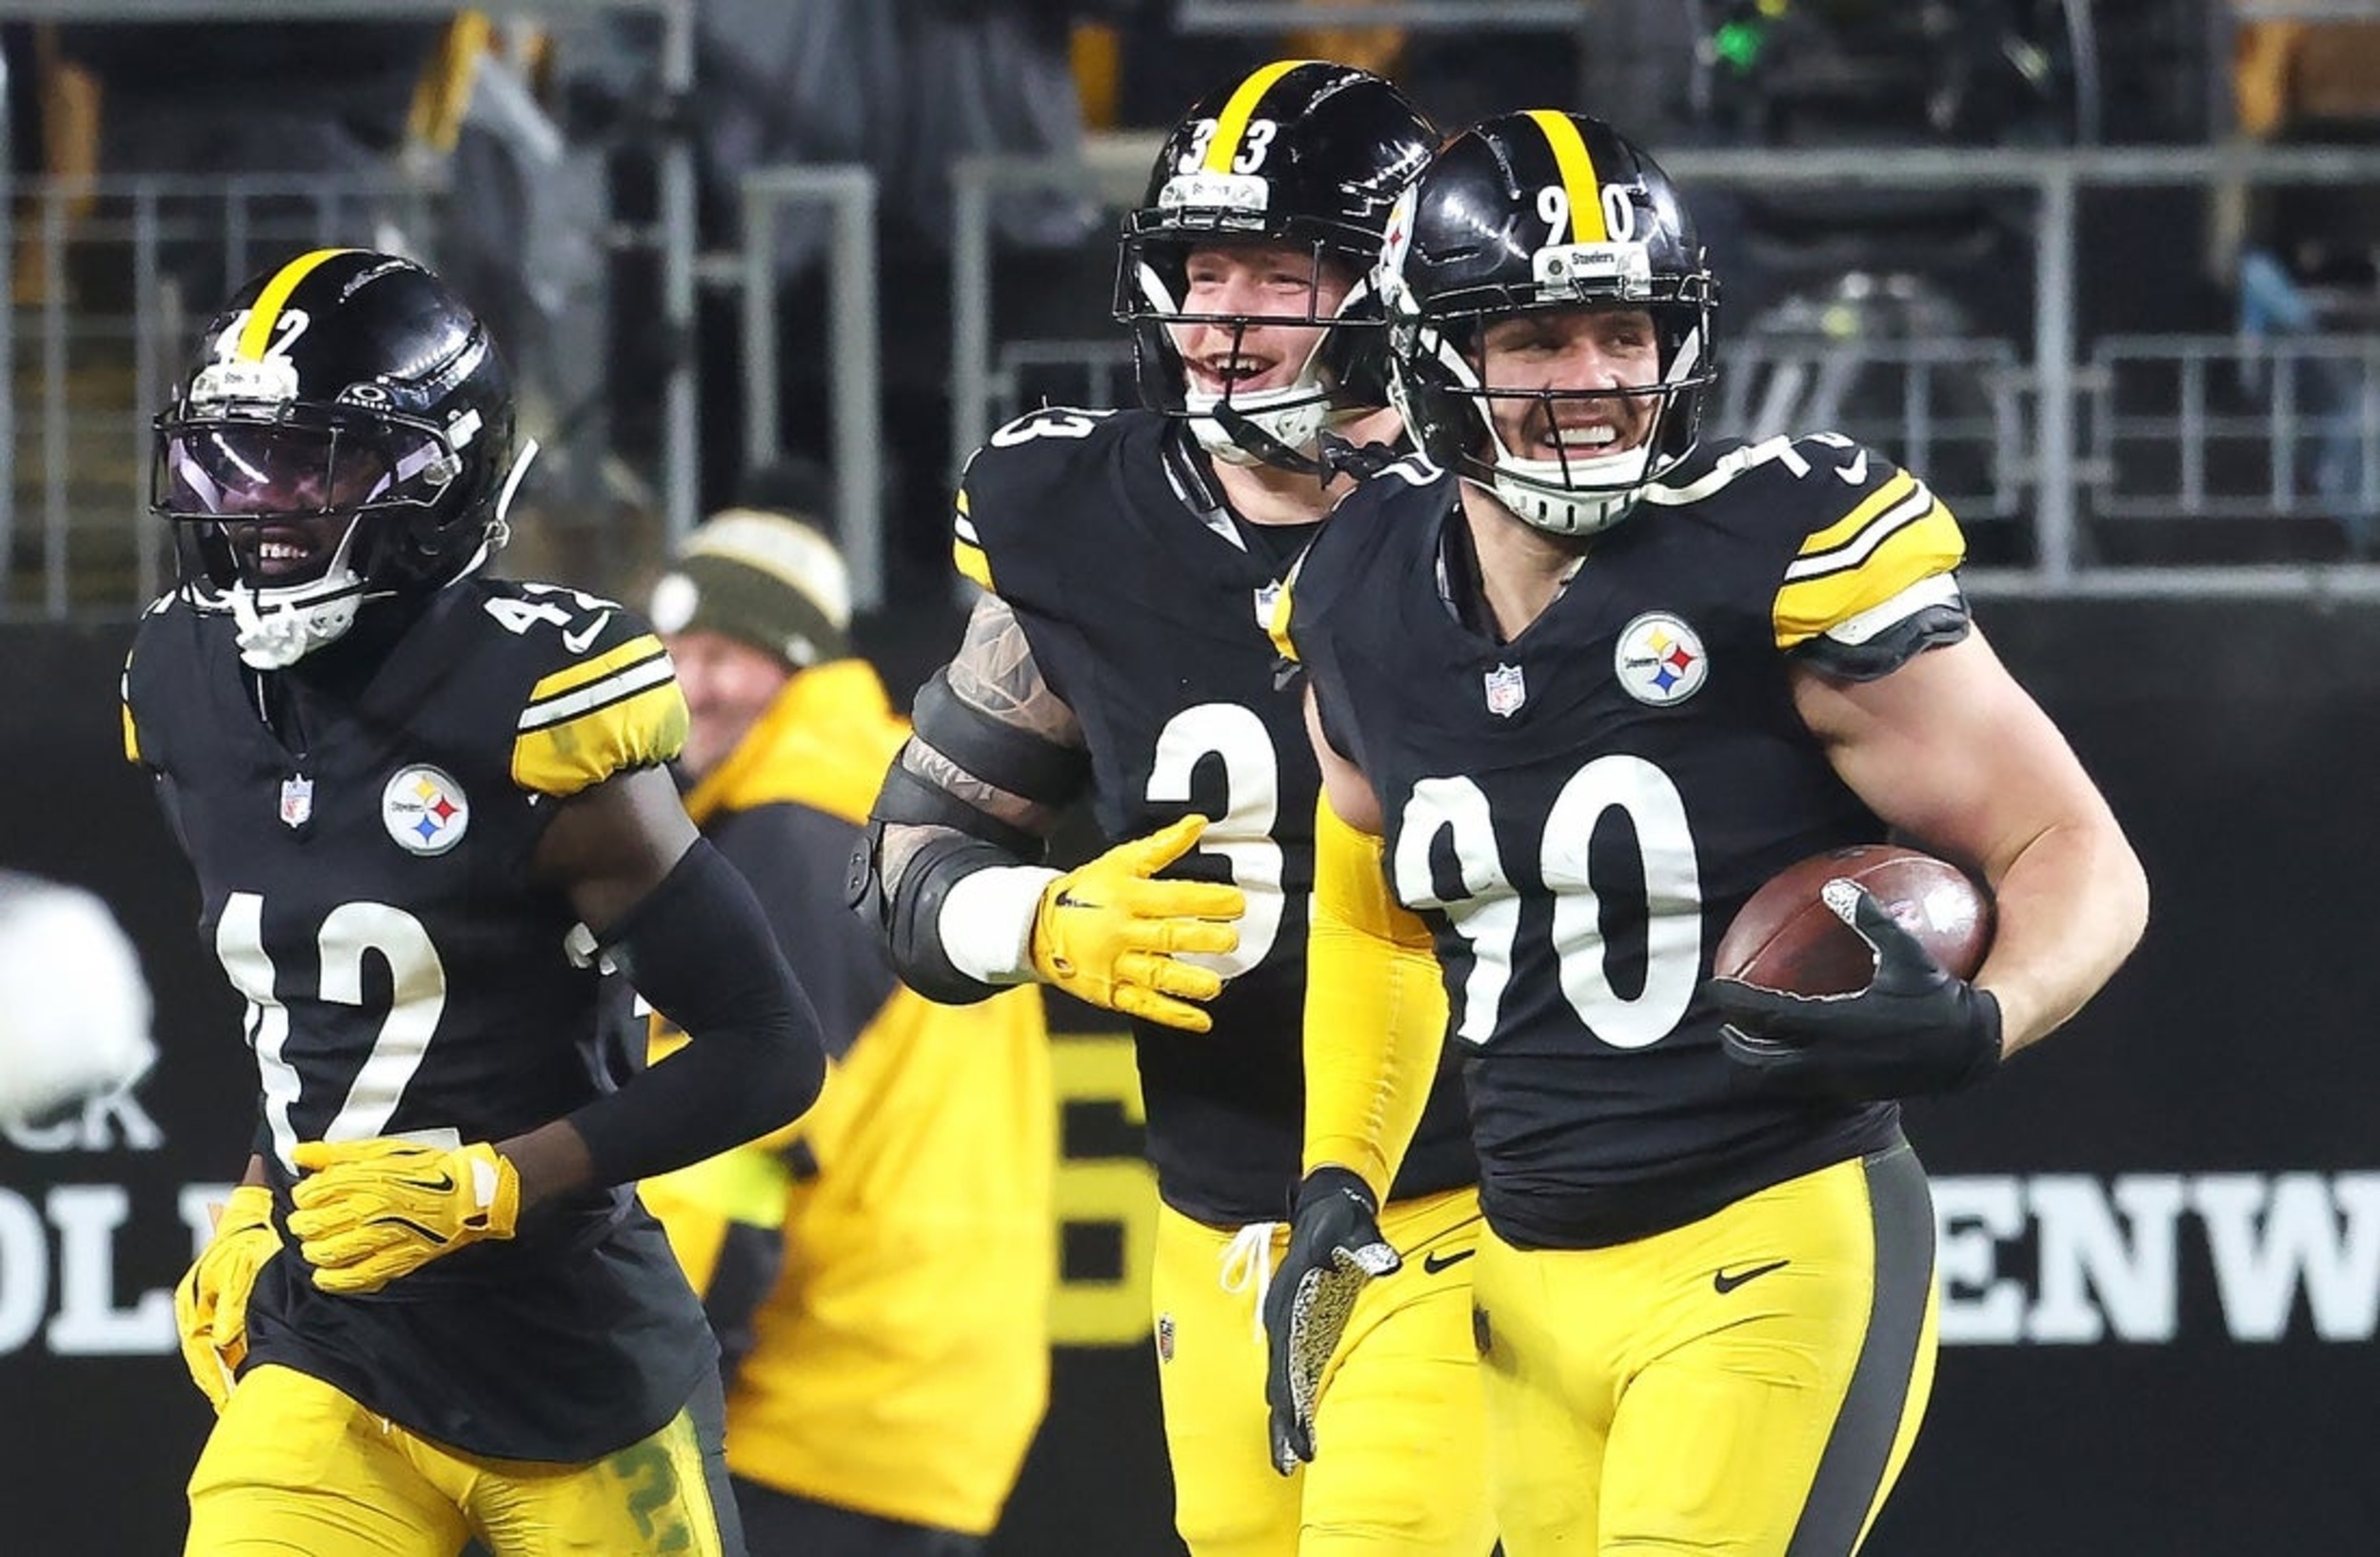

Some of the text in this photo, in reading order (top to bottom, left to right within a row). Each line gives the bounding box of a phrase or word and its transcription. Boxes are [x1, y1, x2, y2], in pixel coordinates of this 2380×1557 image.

[1179, 118, 1277, 174] 33
[1537, 183, 1636, 246] 90
[1572, 251, 1615, 265] Steelers
[1394, 755, 1703, 1047] 90
[1933, 1172, 2380, 1345] ENW
